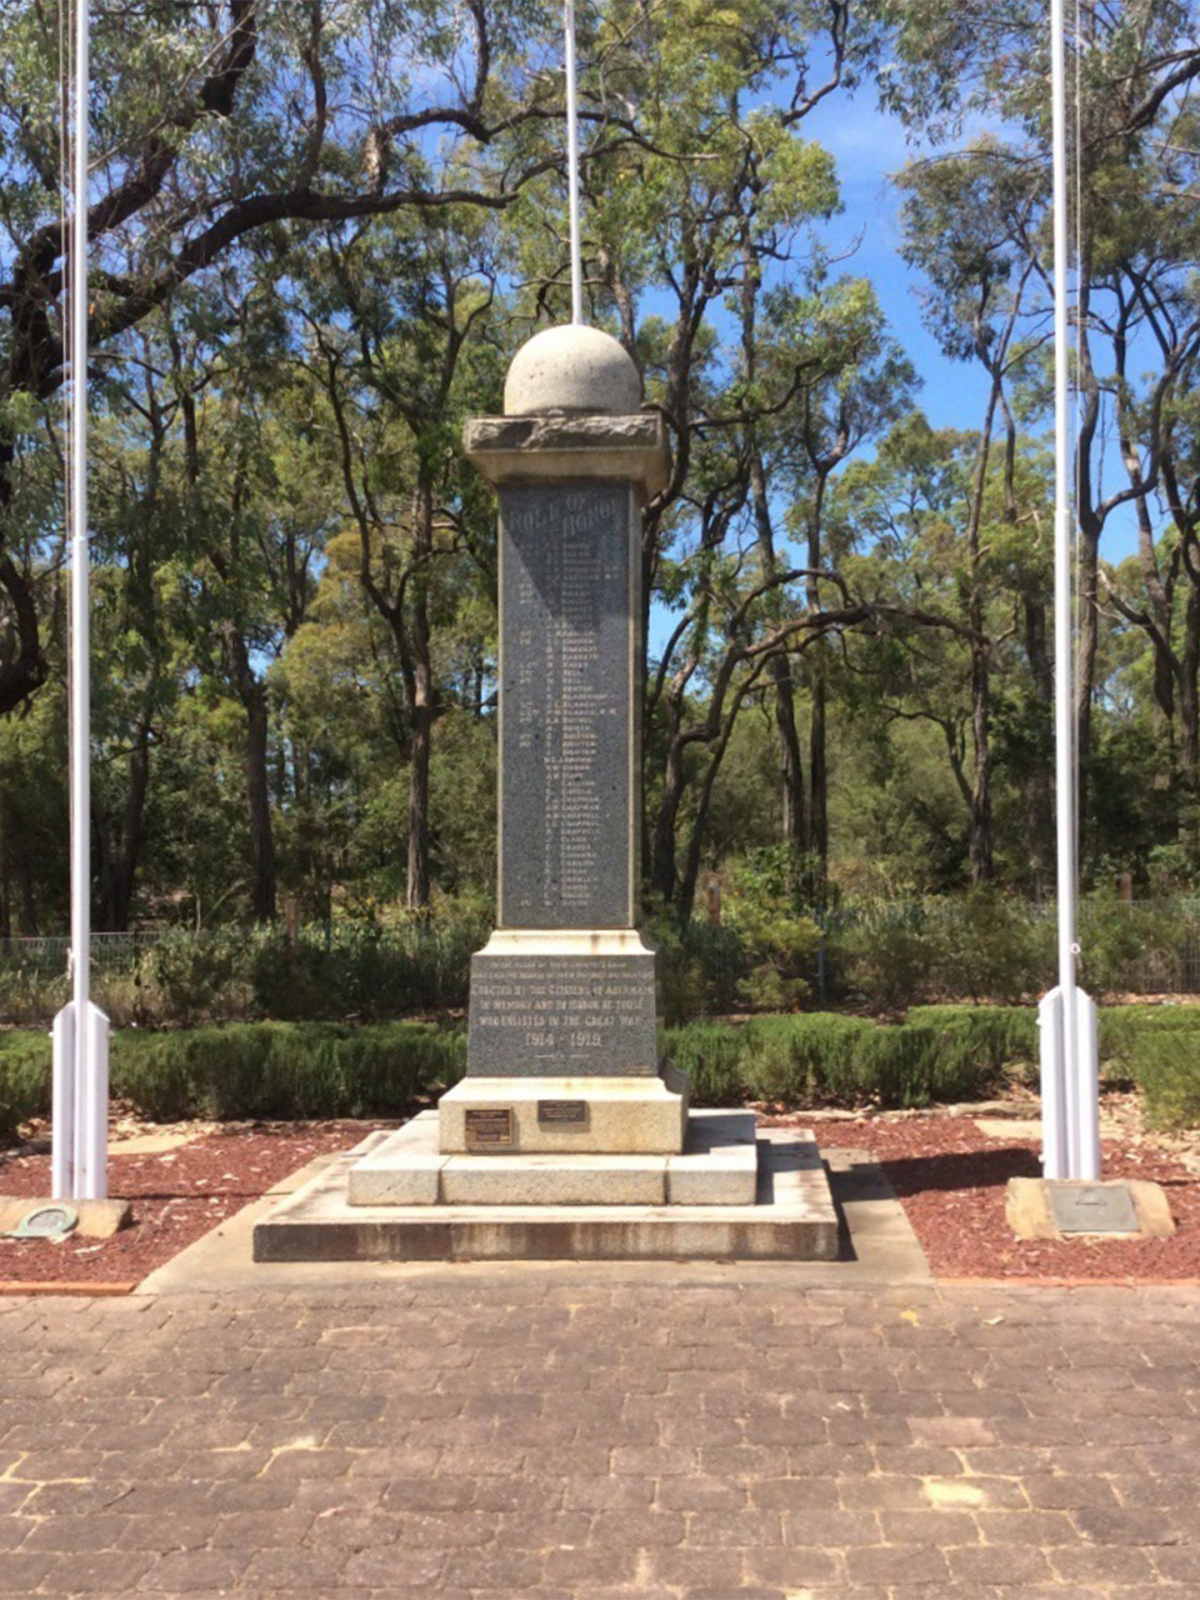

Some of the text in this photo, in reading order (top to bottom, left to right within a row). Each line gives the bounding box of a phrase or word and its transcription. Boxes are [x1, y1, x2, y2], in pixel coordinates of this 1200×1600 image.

[549, 1015, 560, 1026] IN
[563, 1015, 580, 1026] THE
[585, 1015, 615, 1026] GREAT
[525, 1032, 555, 1047] 1914
[569, 1032, 602, 1047] 1919
